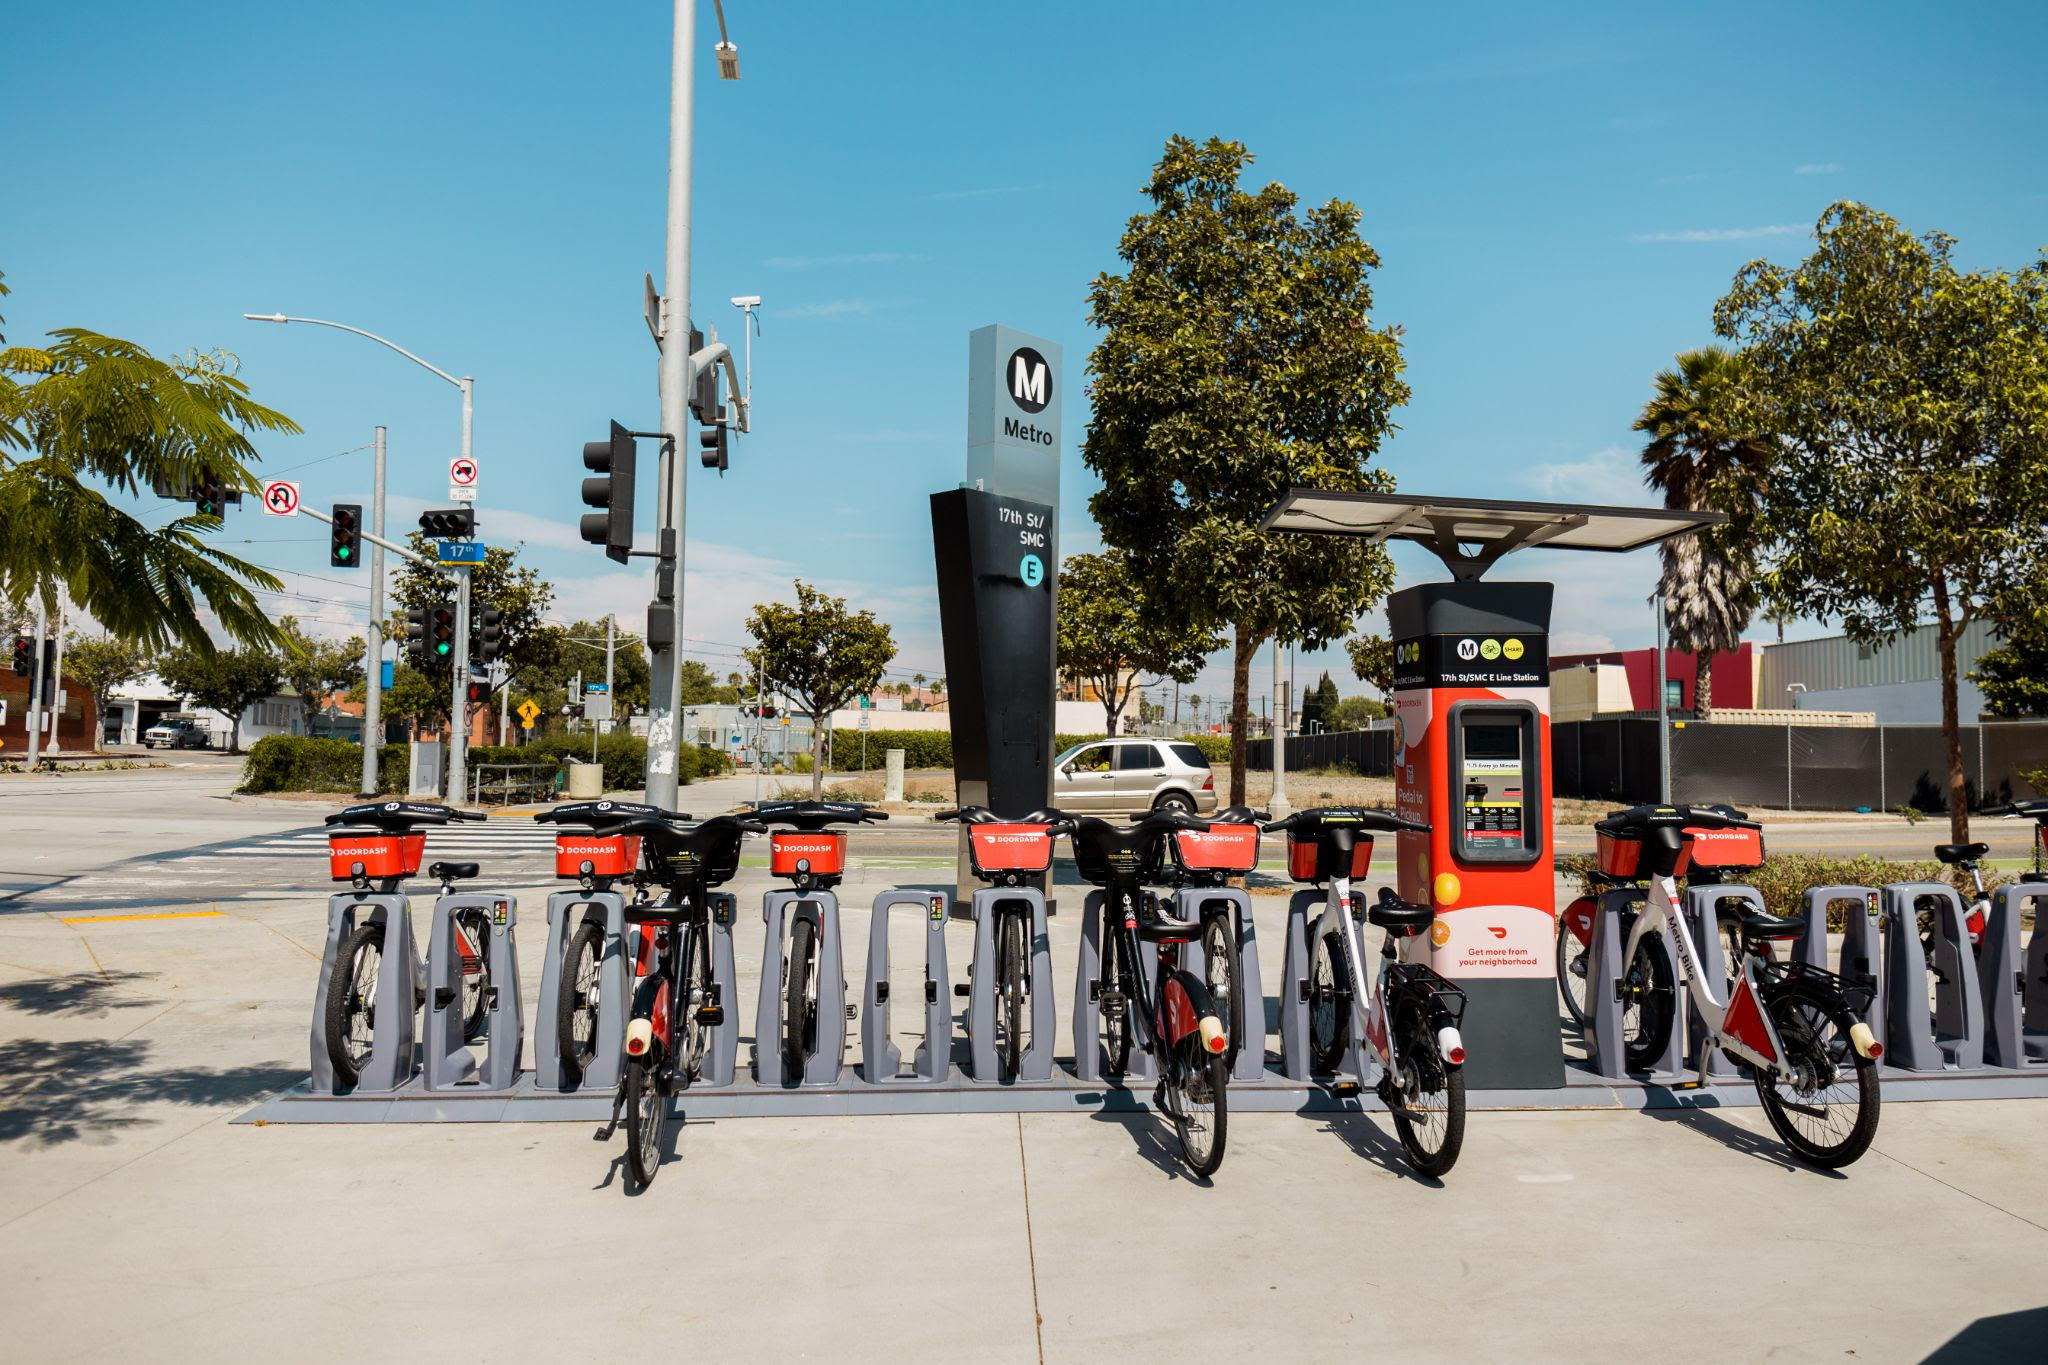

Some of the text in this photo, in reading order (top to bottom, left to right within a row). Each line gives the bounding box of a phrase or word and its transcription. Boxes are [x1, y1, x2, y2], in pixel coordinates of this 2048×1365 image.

[1014, 355, 1046, 406] M
[1004, 416, 1053, 446] Metro
[999, 507, 1045, 529] 17th St/
[1019, 530, 1045, 548] SMC
[450, 545, 474, 558] 17th
[1026, 560, 1037, 580] E
[1461, 643, 1475, 656] M
[1441, 673, 1540, 683] 17th St/SMC E Line Station
[1398, 788, 1423, 805] Pedal to
[1707, 833, 1749, 841] DOORDASH
[337, 847, 388, 856] DOORDASH
[566, 846, 617, 854] DOORDASH
[1468, 948, 1484, 956] Get
[1508, 948, 1528, 956] from
[1667, 916, 1695, 982] Metro Bike
[1341, 925, 1358, 995] Metro Bike
[1458, 957, 1538, 968] your neighborhood
